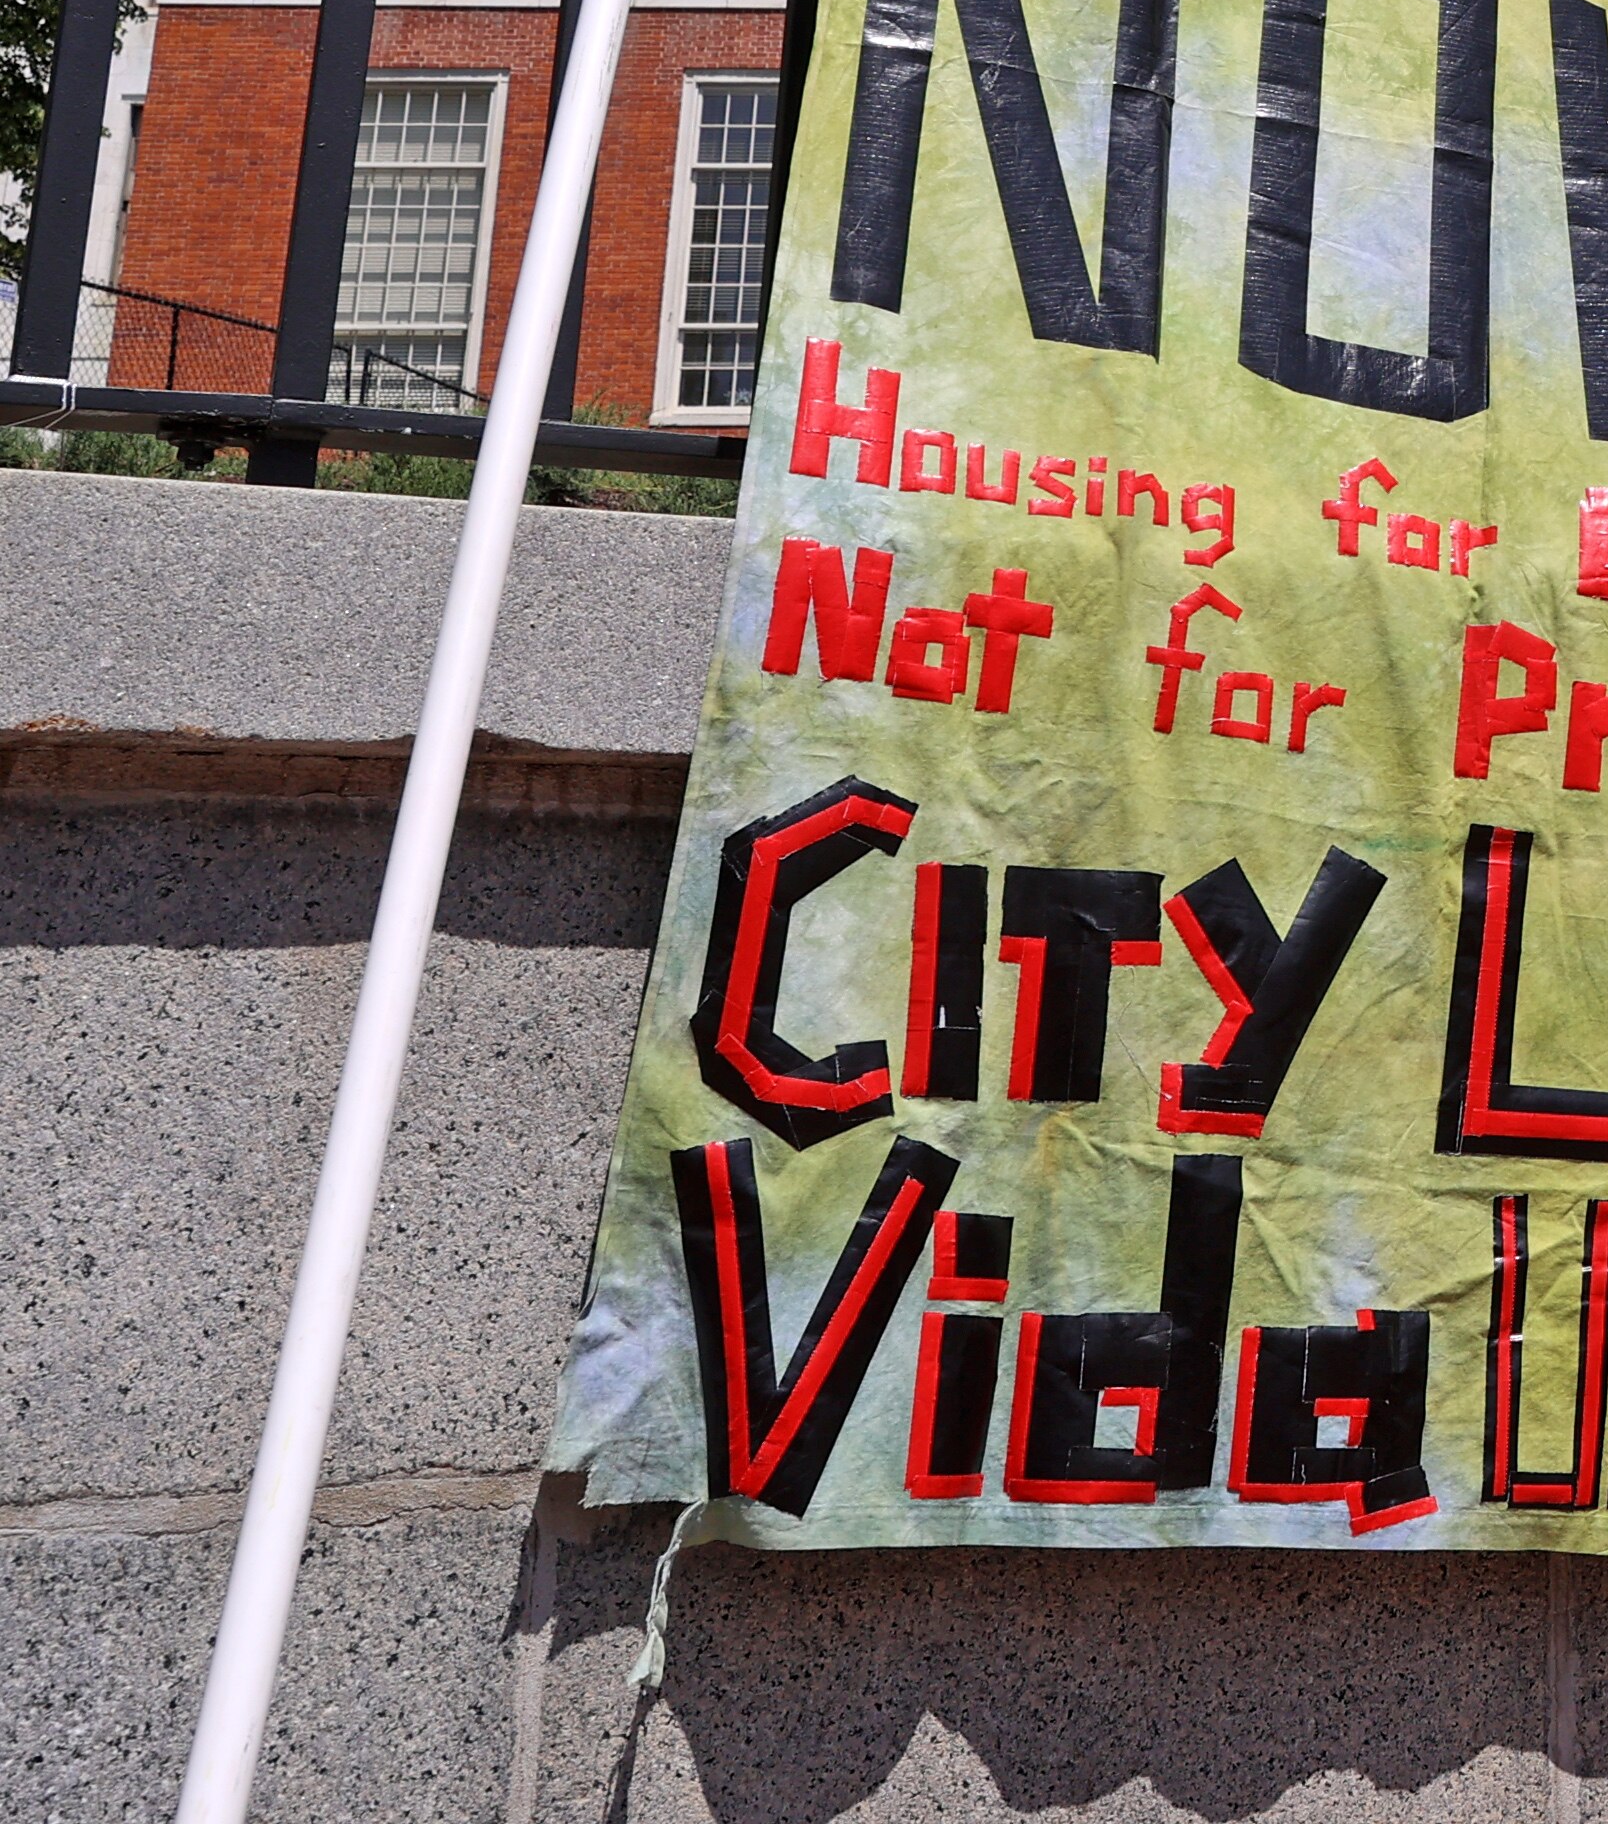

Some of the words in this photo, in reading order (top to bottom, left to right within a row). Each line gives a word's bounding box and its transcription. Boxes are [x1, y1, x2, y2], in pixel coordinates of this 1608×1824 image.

[788, 335, 1236, 567] Housing
[1320, 456, 1498, 577] for
[760, 537, 1054, 714] Not
[1145, 583, 1346, 753] for
[669, 1135, 1438, 1537] Vida
